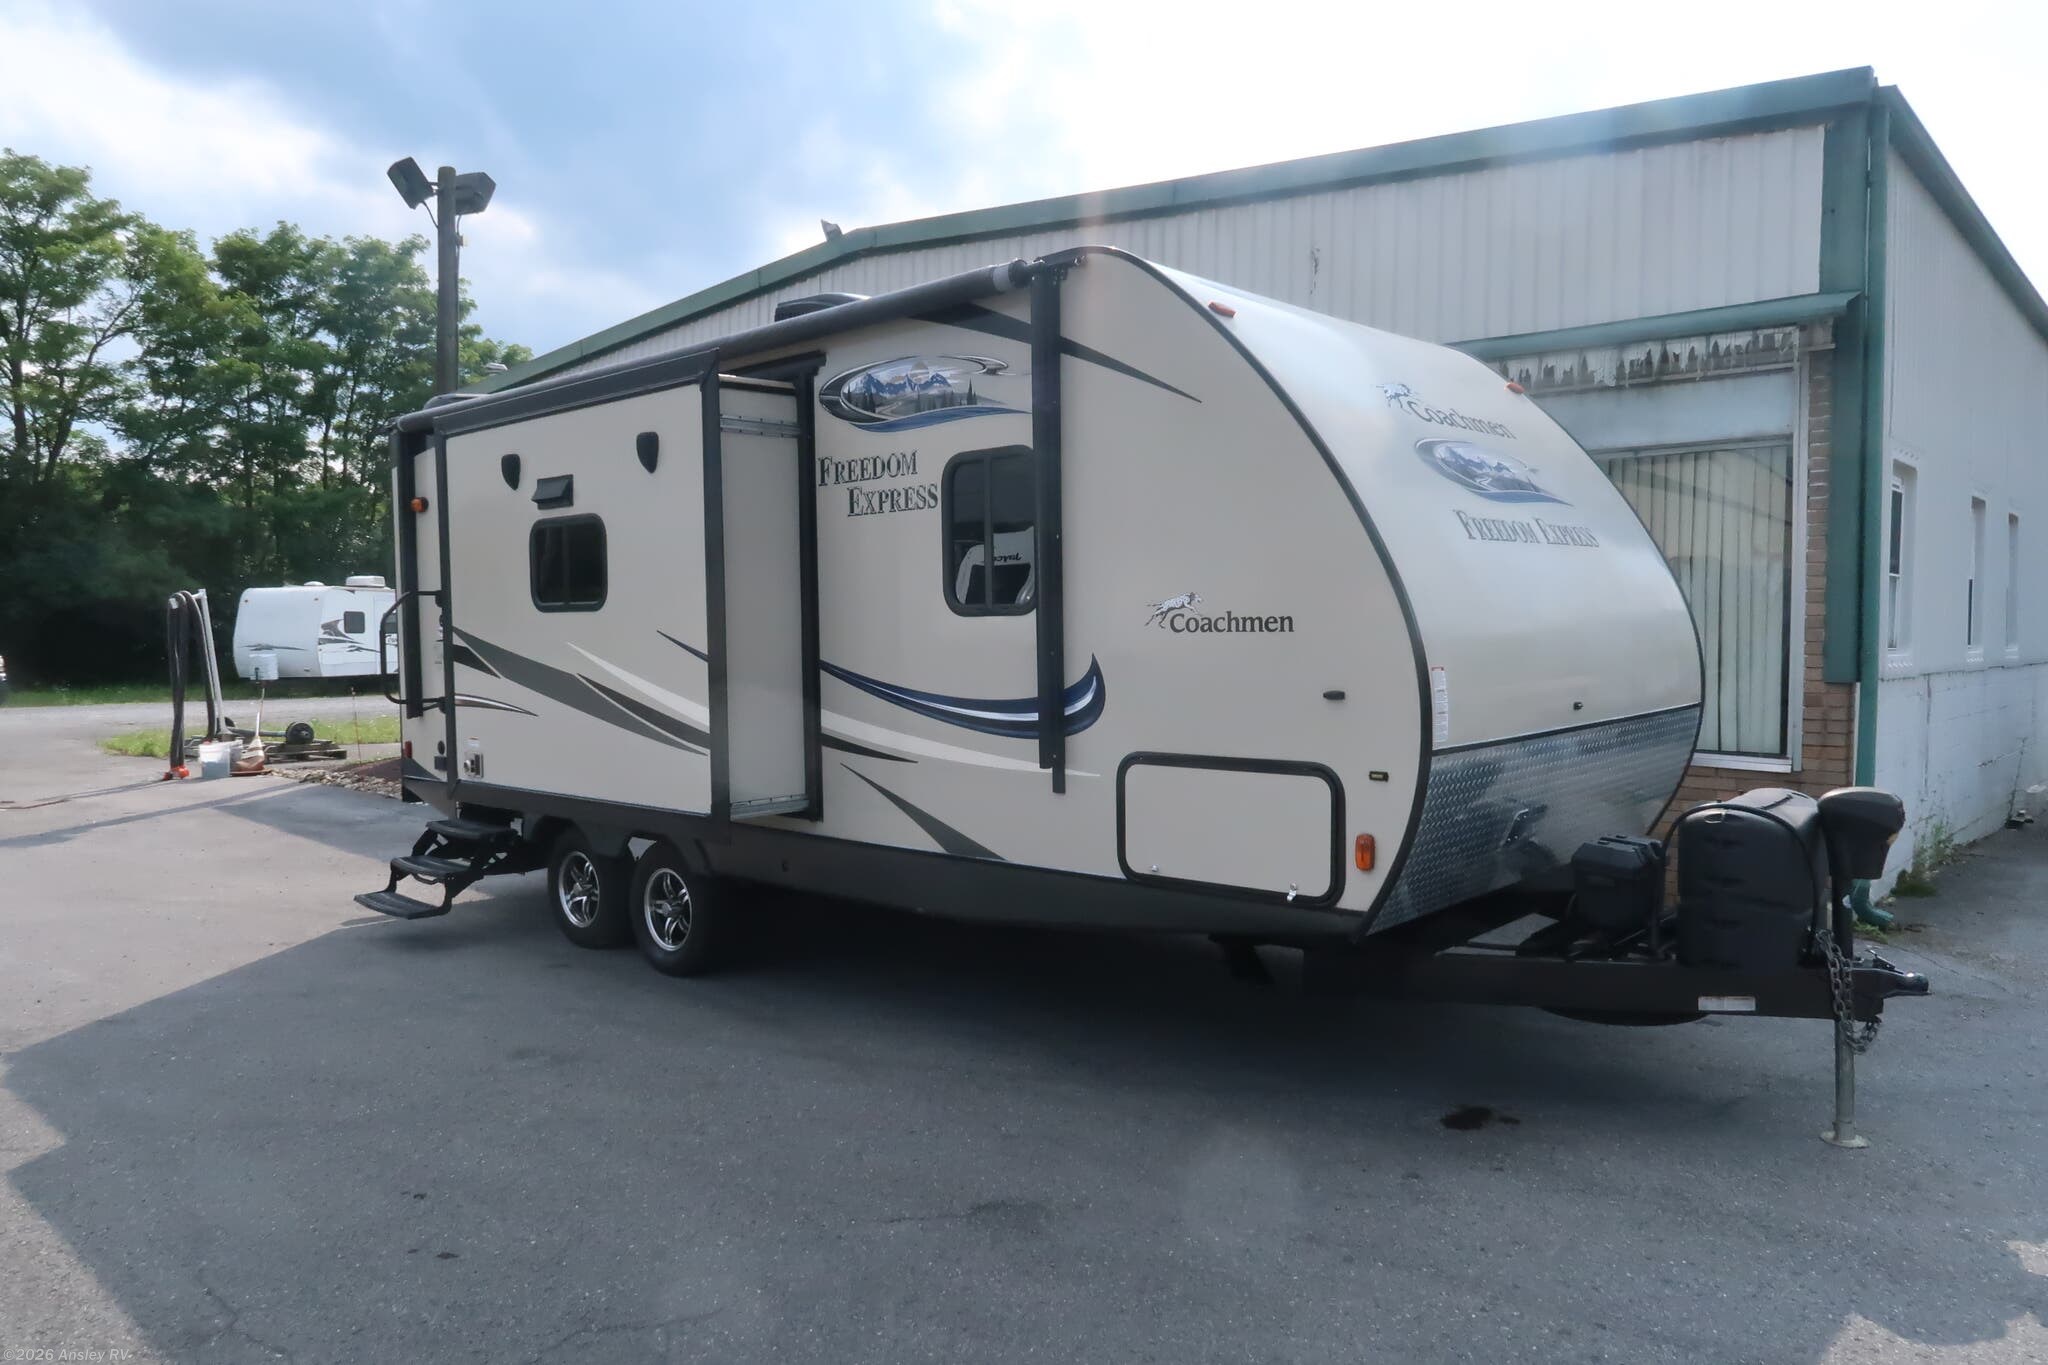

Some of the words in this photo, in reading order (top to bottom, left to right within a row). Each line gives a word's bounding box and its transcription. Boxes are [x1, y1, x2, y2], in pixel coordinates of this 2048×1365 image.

[1407, 400, 1517, 440] Coachmen
[818, 451, 918, 486] FREEDOM
[847, 483, 939, 517] EXPRESS
[1454, 510, 1540, 543] FREEDOM
[1535, 517, 1599, 548] EXPRESS
[1169, 611, 1295, 633] Coachmen
